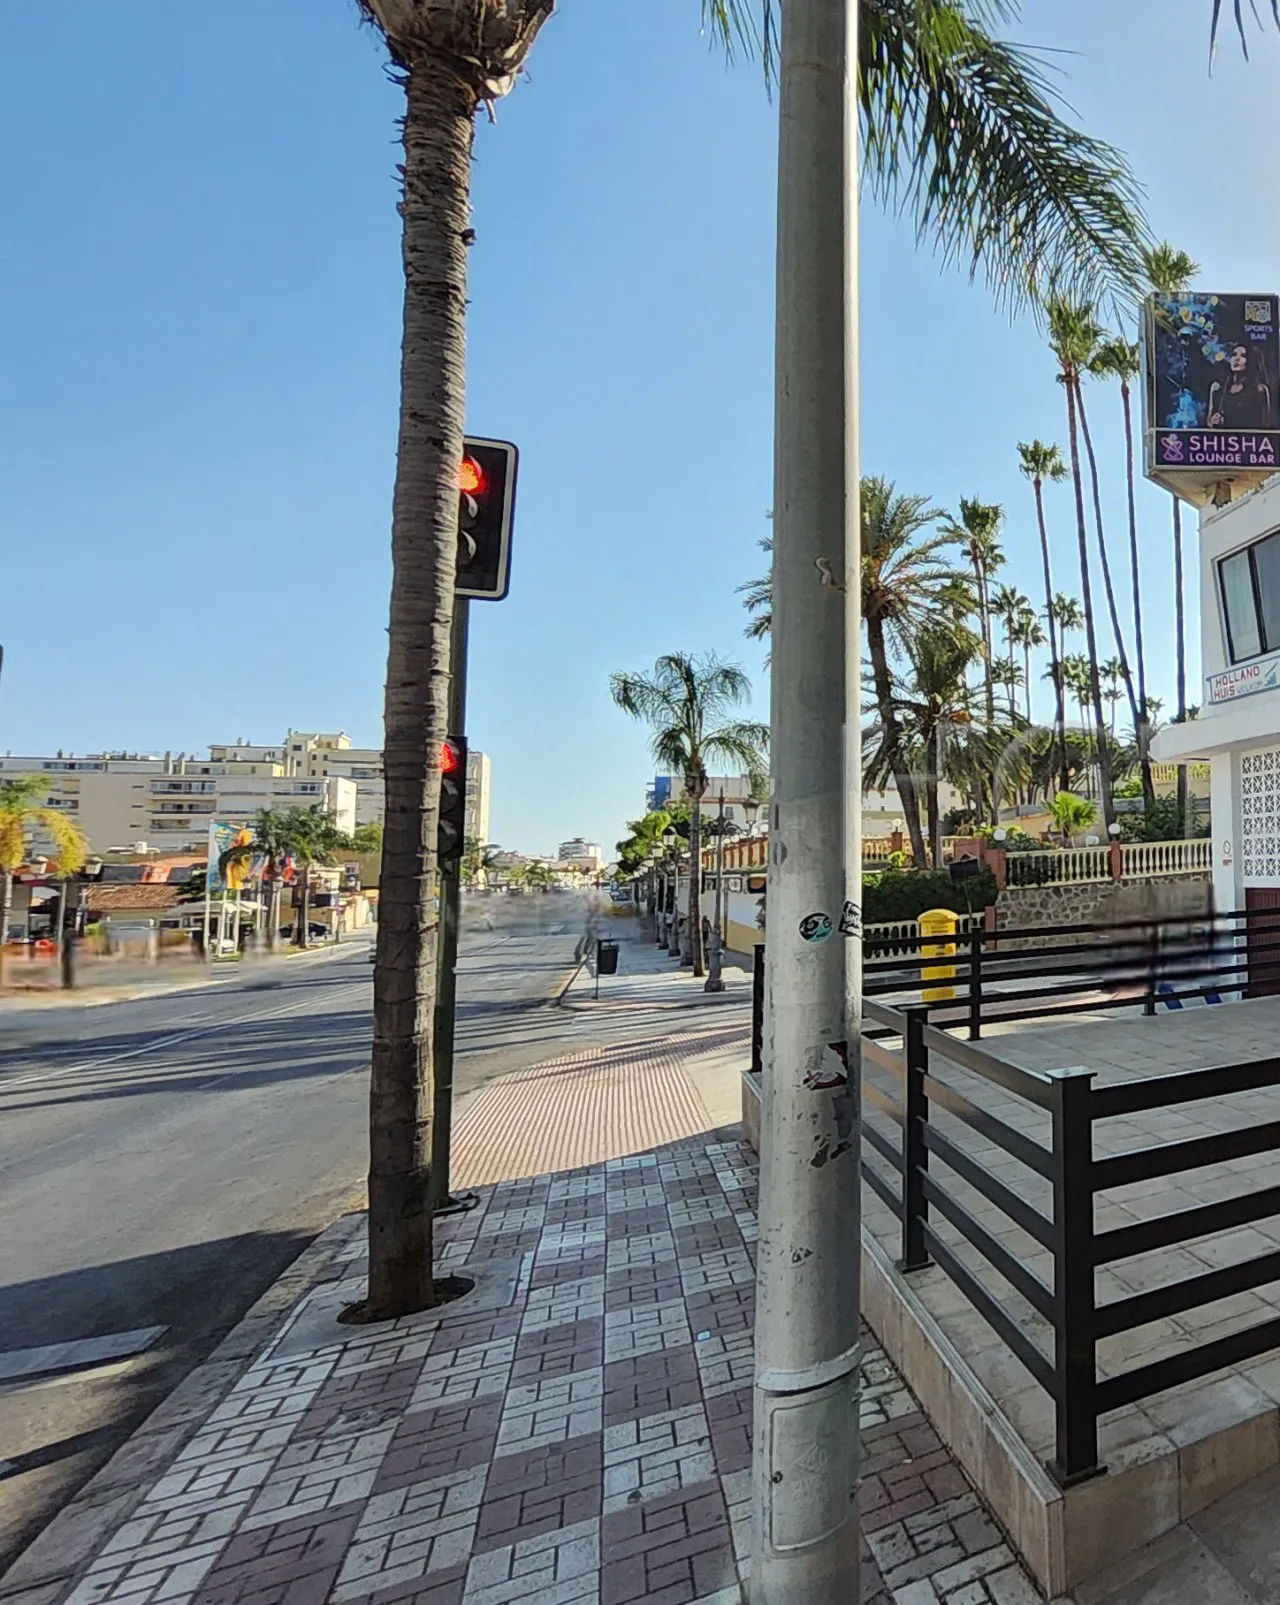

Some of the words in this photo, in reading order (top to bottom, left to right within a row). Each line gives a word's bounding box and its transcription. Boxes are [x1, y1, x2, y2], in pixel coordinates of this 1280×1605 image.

[1243, 324, 1274, 333] SPORTS
[1250, 333, 1267, 341] BAR
[1189, 435, 1275, 453] SHISHA
[1189, 452, 1242, 463] LOUNGE
[1249, 454, 1275, 464] BAR
[1215, 665, 1260, 688] HOLLAND
[1214, 686, 1236, 701] HUIS
